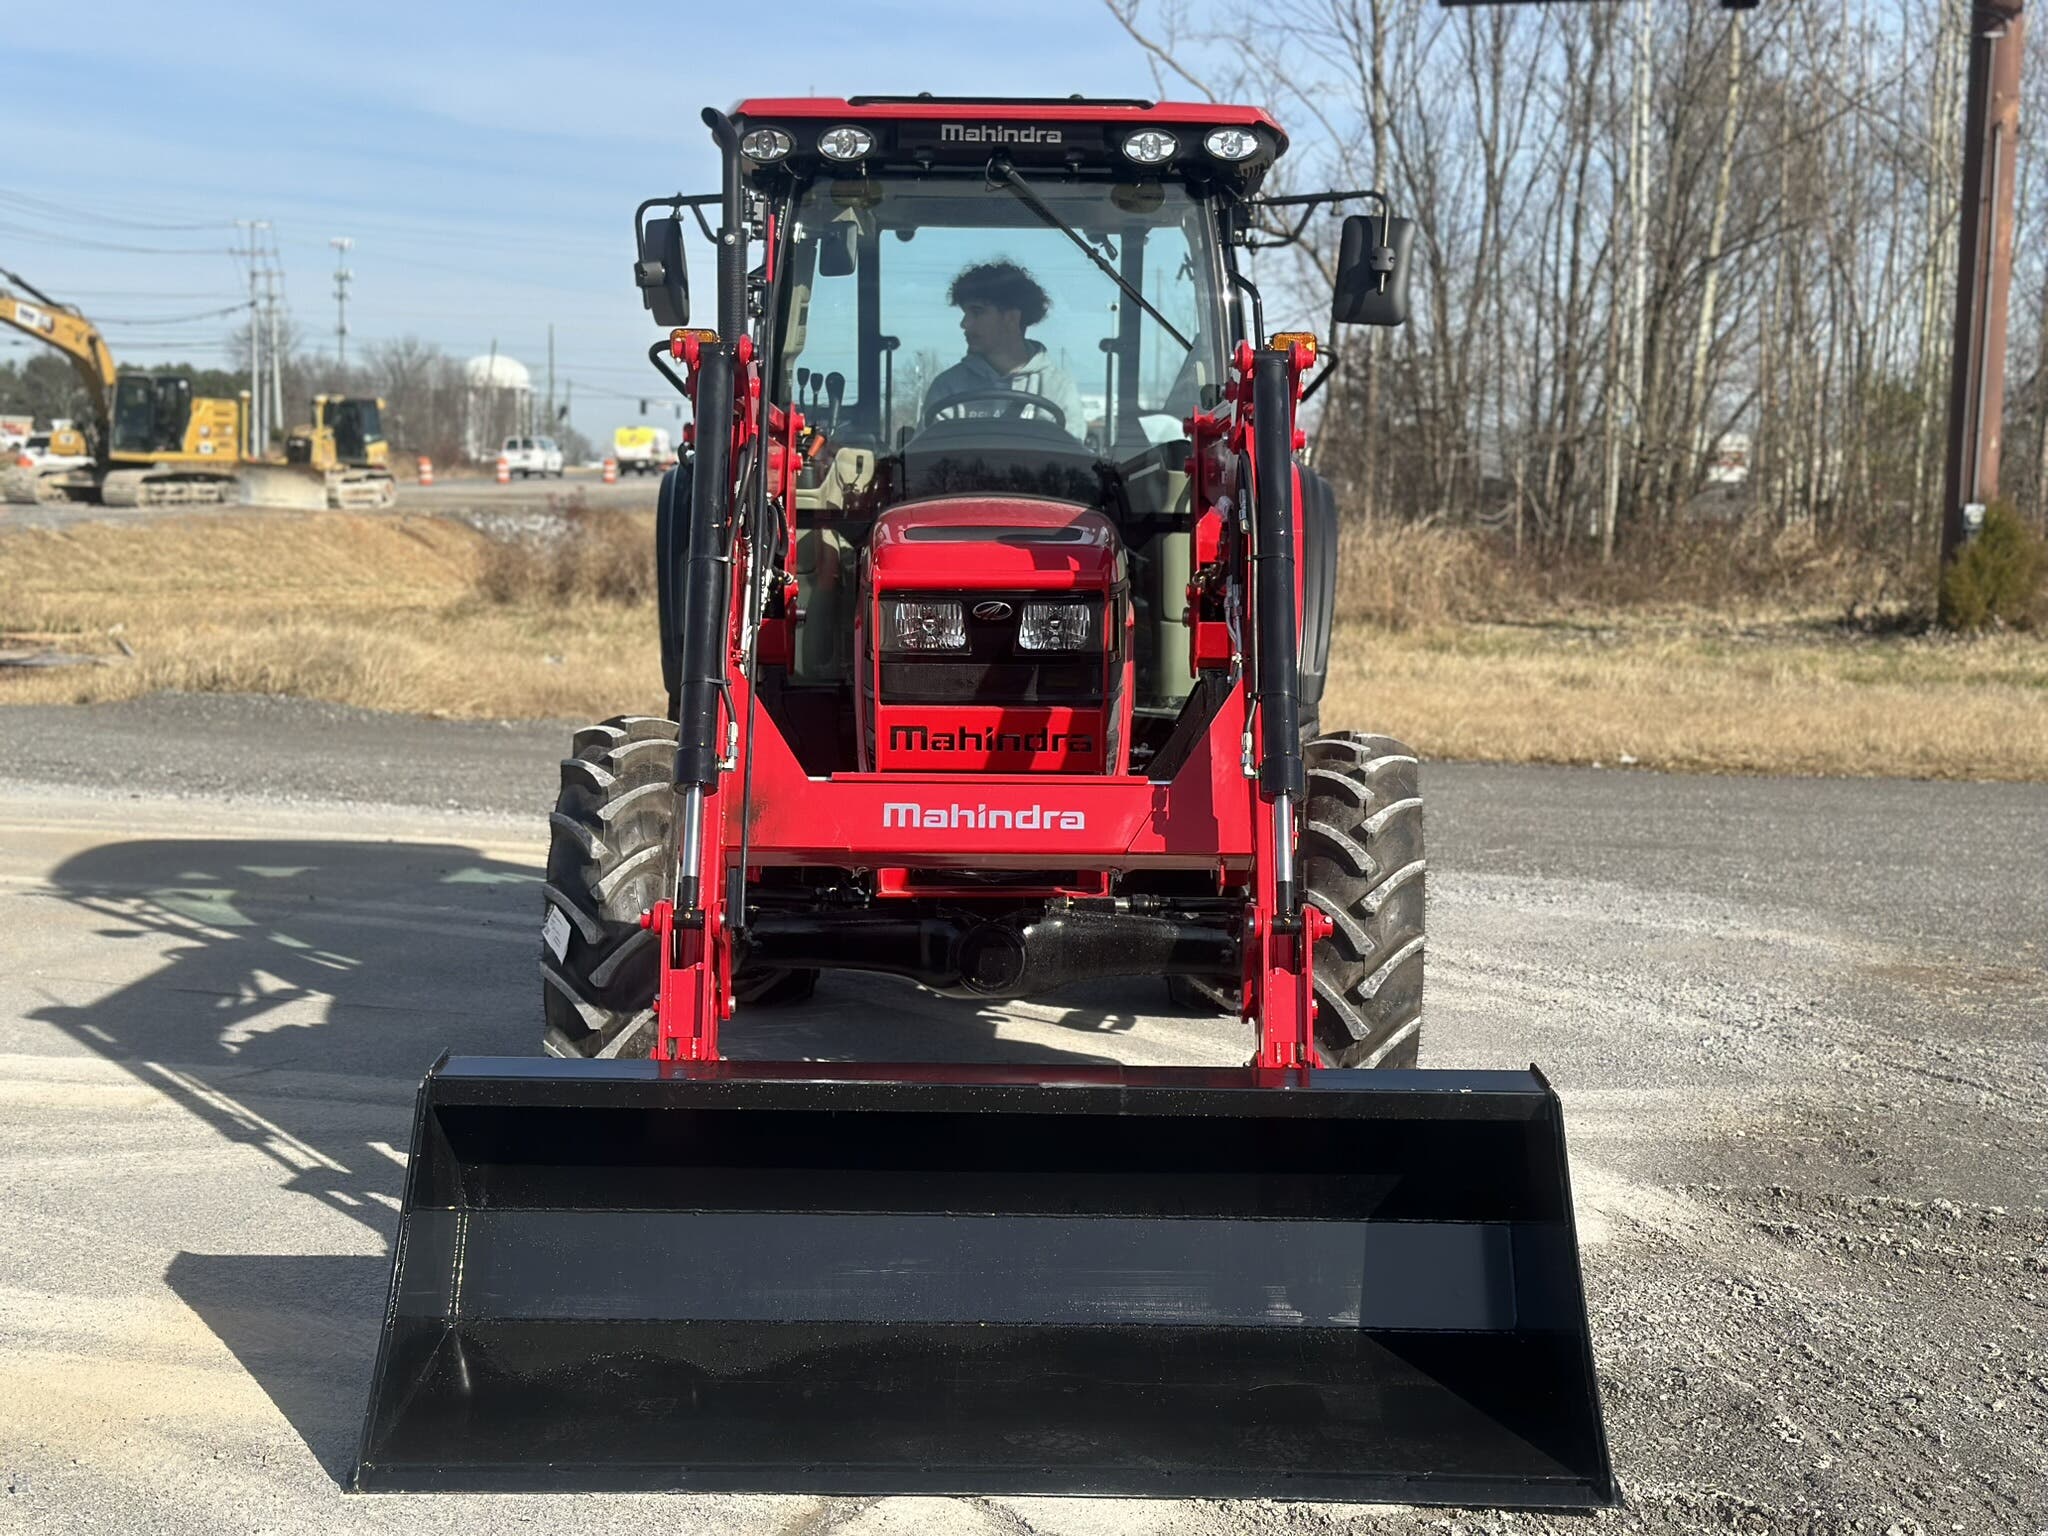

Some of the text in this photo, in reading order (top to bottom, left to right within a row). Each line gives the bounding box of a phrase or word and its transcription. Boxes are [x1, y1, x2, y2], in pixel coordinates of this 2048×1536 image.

[941, 124, 1062, 143] Mahindra
[890, 726, 1093, 752] Mahindra
[883, 802, 1085, 830] Mahindra
